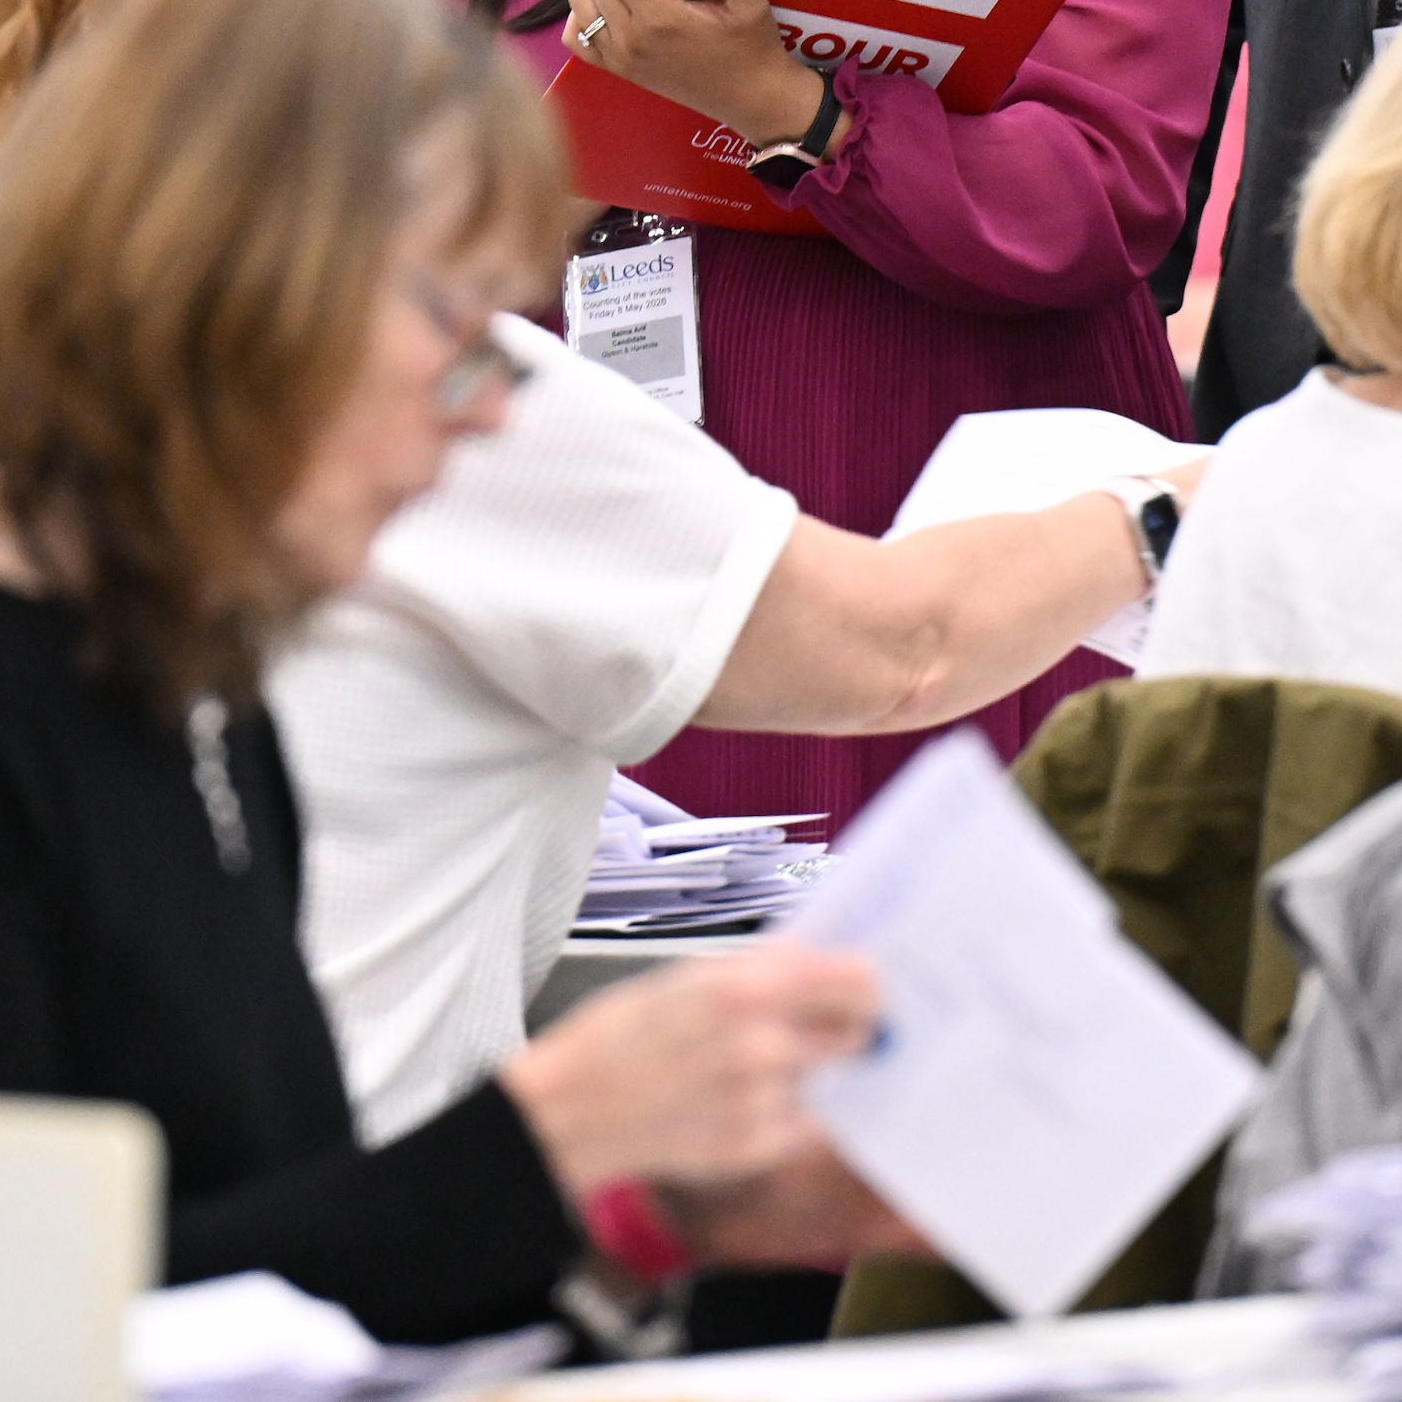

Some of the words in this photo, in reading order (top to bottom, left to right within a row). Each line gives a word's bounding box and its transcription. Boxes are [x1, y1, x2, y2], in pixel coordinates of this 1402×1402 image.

[778, 22, 930, 76] BOUR
[611, 254, 674, 282] Leeds
[583, 296, 620, 311] Counting
[623, 293, 631, 302] of
[633, 291, 646, 299] the
[650, 287, 672, 296] votes
[589, 308, 615, 319] Friday
[626, 302, 643, 312] May
[612, 336, 646, 347] Candidate
